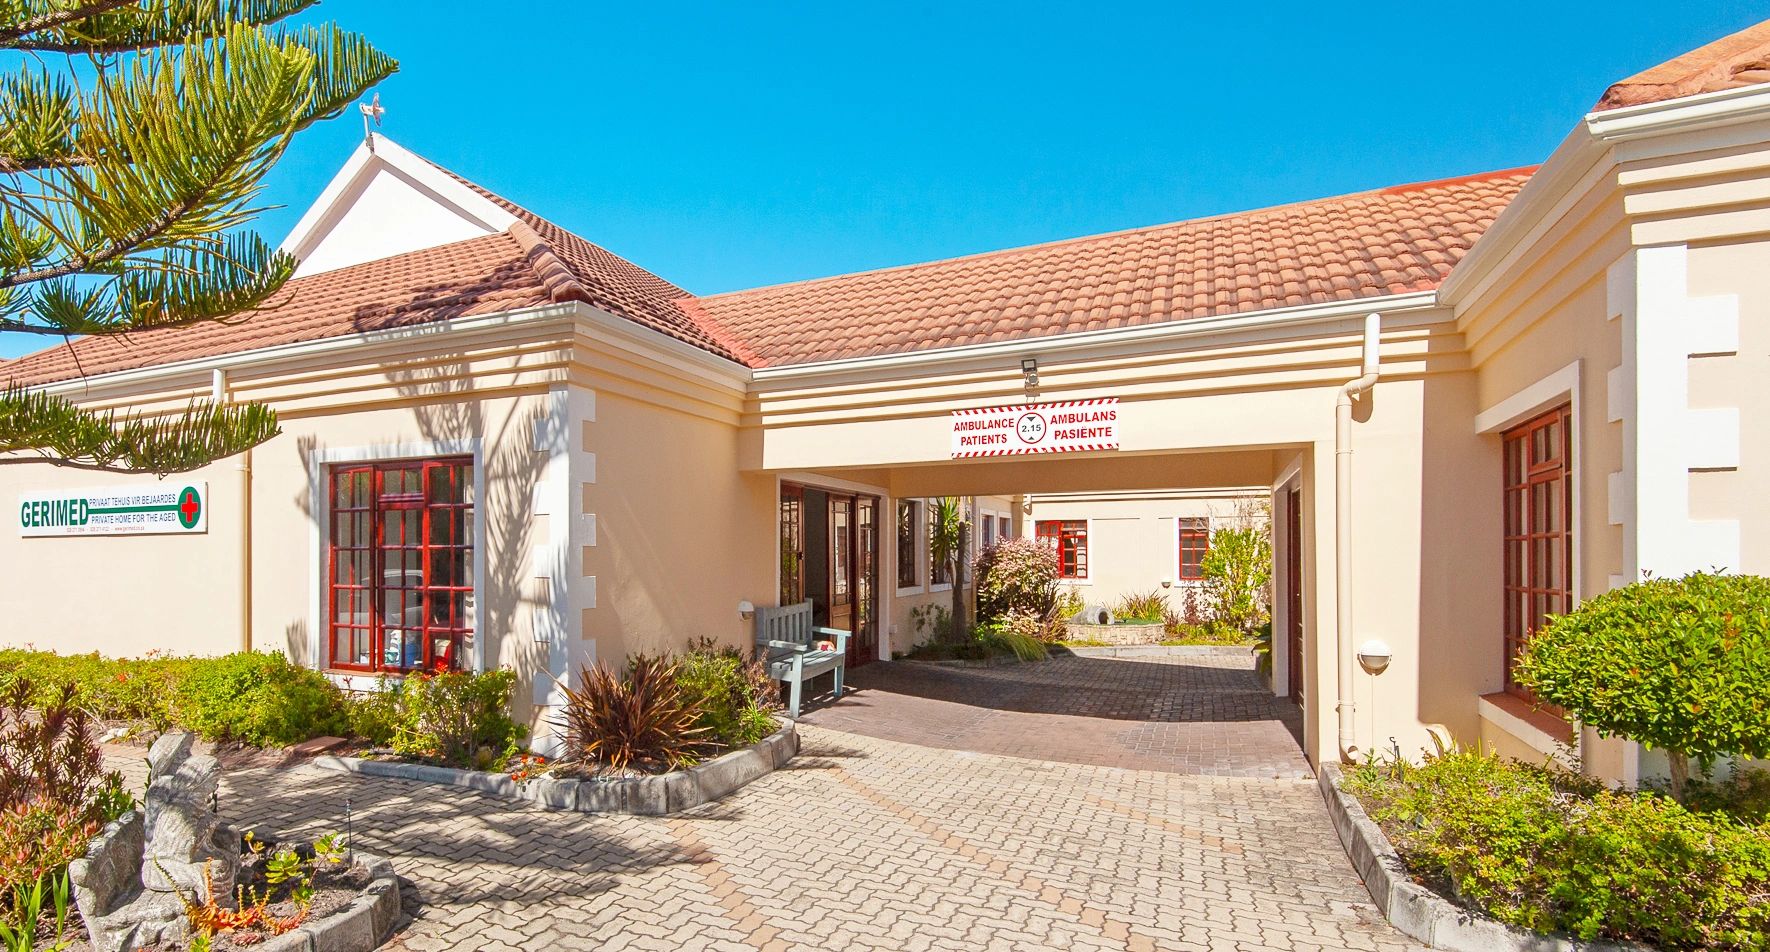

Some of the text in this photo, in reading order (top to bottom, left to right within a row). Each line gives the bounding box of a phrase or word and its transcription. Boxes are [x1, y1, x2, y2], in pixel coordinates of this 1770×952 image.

[1050, 410, 1117, 425] AMBULANS
[953, 418, 1015, 431] AMBULANCE
[1021, 424, 1042, 433] 2.15
[960, 433, 1008, 446] PATIENTS
[1054, 427, 1113, 440] PASIËNTE
[89, 493, 176, 507] PRIVAAT TEHUIS VIR BEJAARDES
[21, 498, 89, 528] GERIMED
[91, 512, 176, 524] PRIVATE HOME FOR THE AGED
